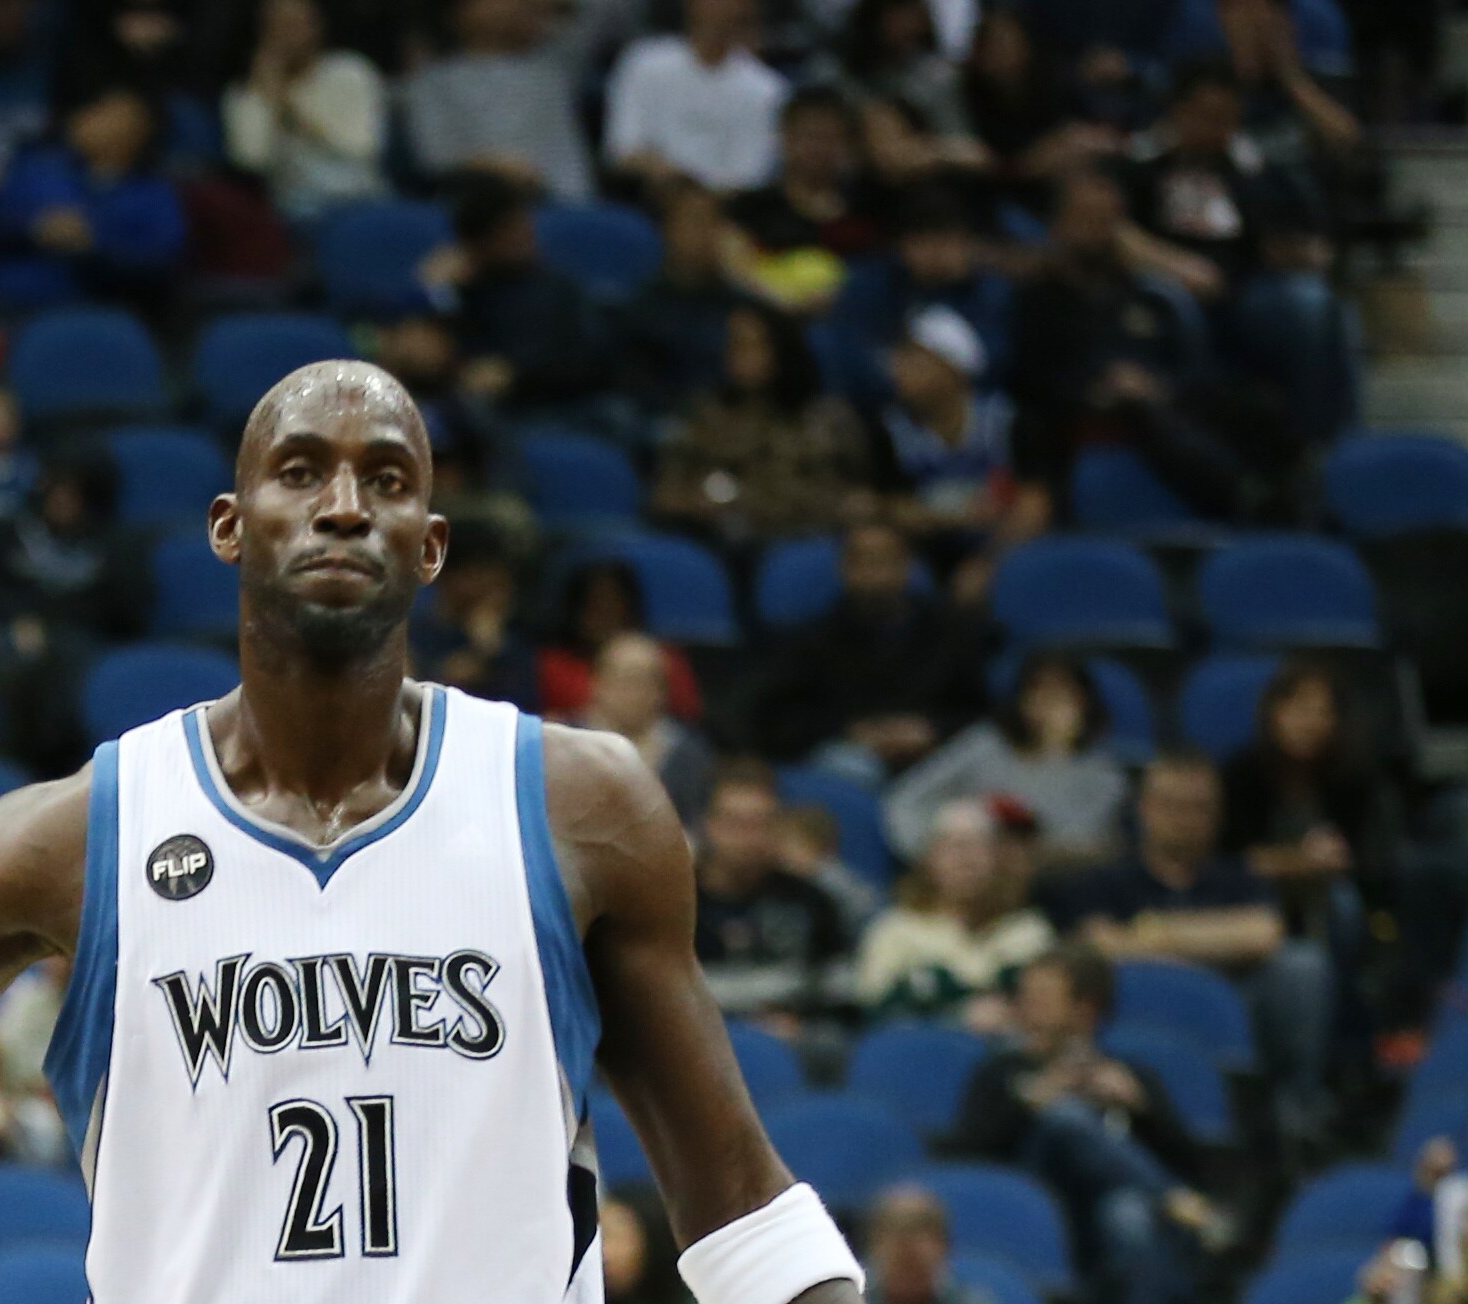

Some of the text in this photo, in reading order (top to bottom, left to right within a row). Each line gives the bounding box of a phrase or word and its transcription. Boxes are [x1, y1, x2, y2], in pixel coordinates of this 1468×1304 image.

[152, 851, 207, 881] FLIP
[151, 948, 506, 1095] WOLVES
[268, 1095, 399, 1262] 21
